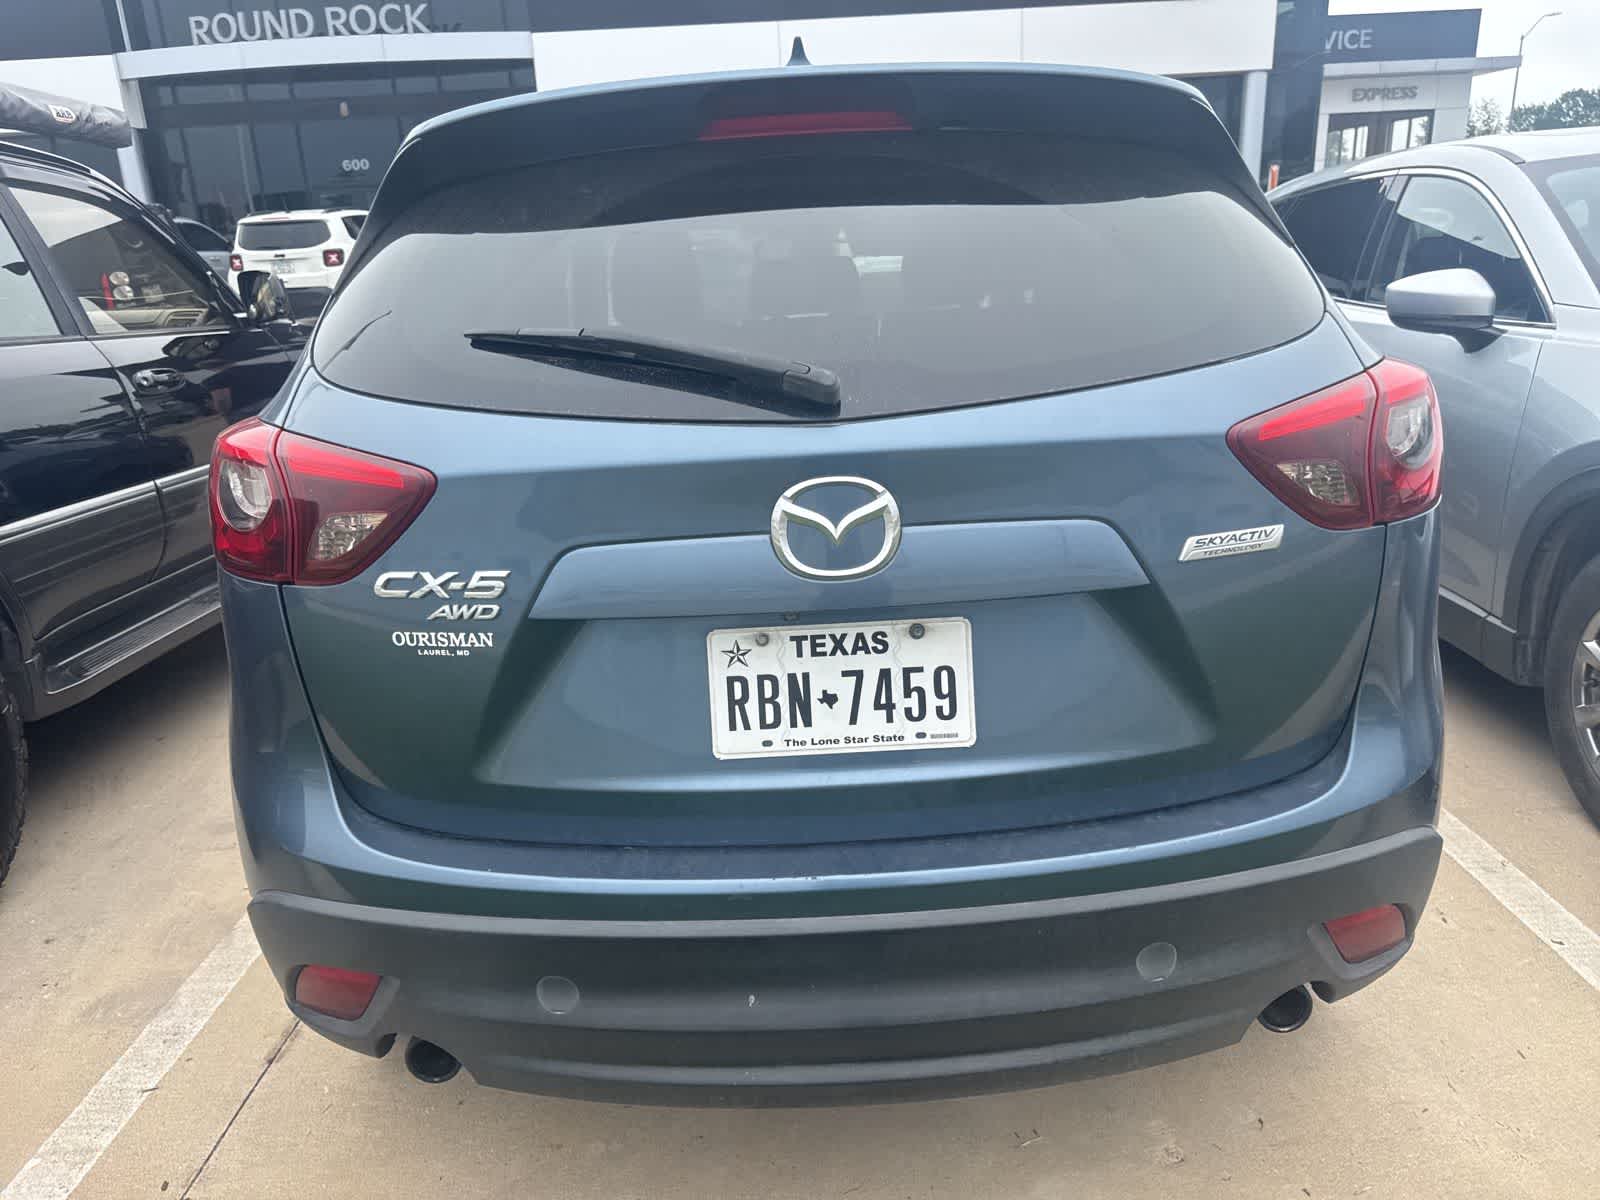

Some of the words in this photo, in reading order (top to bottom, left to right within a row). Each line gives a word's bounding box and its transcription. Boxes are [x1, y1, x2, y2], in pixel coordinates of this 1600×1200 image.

[188, 8, 315, 46] ROUND
[323, 3, 431, 36] ROCK
[1351, 86, 1418, 102] EXPRESS
[342, 158, 369, 171] 600
[1194, 528, 1275, 548] SKYACTIV
[1203, 543, 1264, 556] TECHNOLOGY
[374, 570, 511, 598] CX-5
[426, 604, 500, 620] AWD
[392, 631, 494, 647] OURISMAN
[789, 631, 889, 658] TEXAS
[726, 671, 812, 731] RBN
[841, 665, 958, 726] 7459
[784, 738, 807, 747] The
[811, 737, 840, 746] Lone
[844, 735, 869, 744] Star
[873, 733, 905, 743] State
